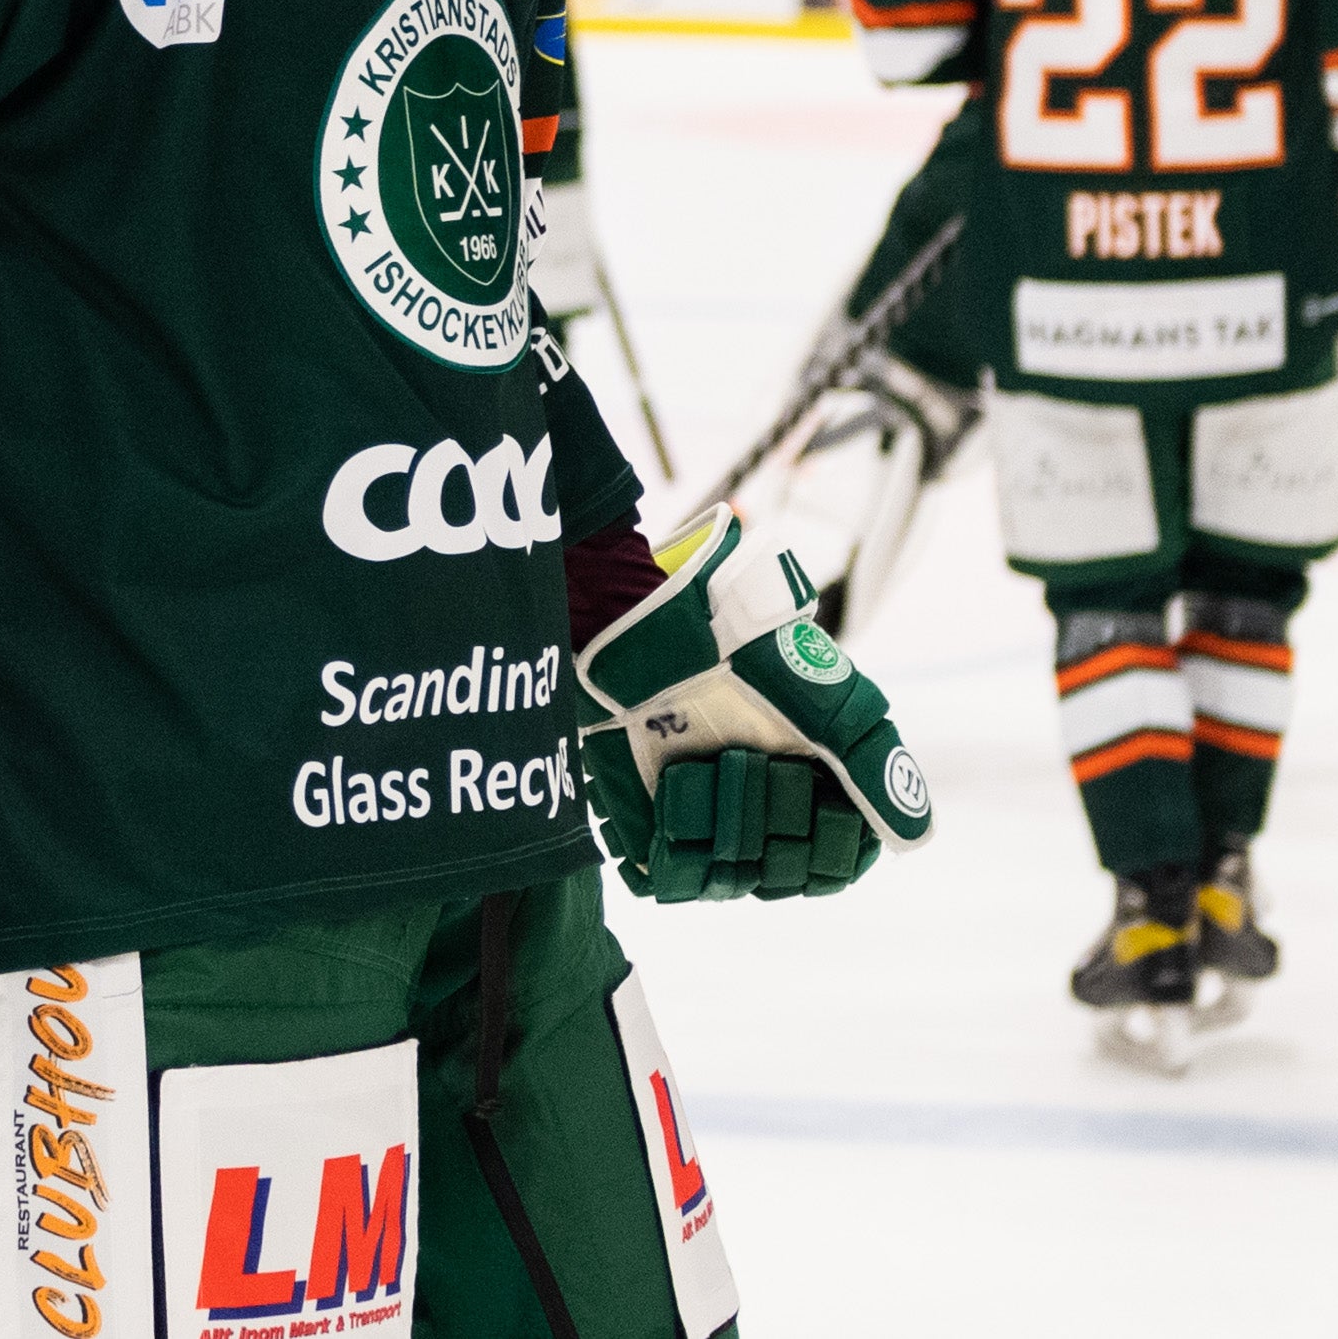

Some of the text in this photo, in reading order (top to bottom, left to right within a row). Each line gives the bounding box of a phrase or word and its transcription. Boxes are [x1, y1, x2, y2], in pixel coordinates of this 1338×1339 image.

[163, 2, 216, 40] ABK
[460, 233, 498, 262] 1966
[1065, 188, 1225, 261] PISTEK
[293, 755, 431, 828] Glass
[14, 1109, 30, 1251] RESTAURANT
[24, 965, 117, 1339] CLUBHOU
[196, 1143, 411, 1321] LM
[349, 1301, 402, 1329] Transport
